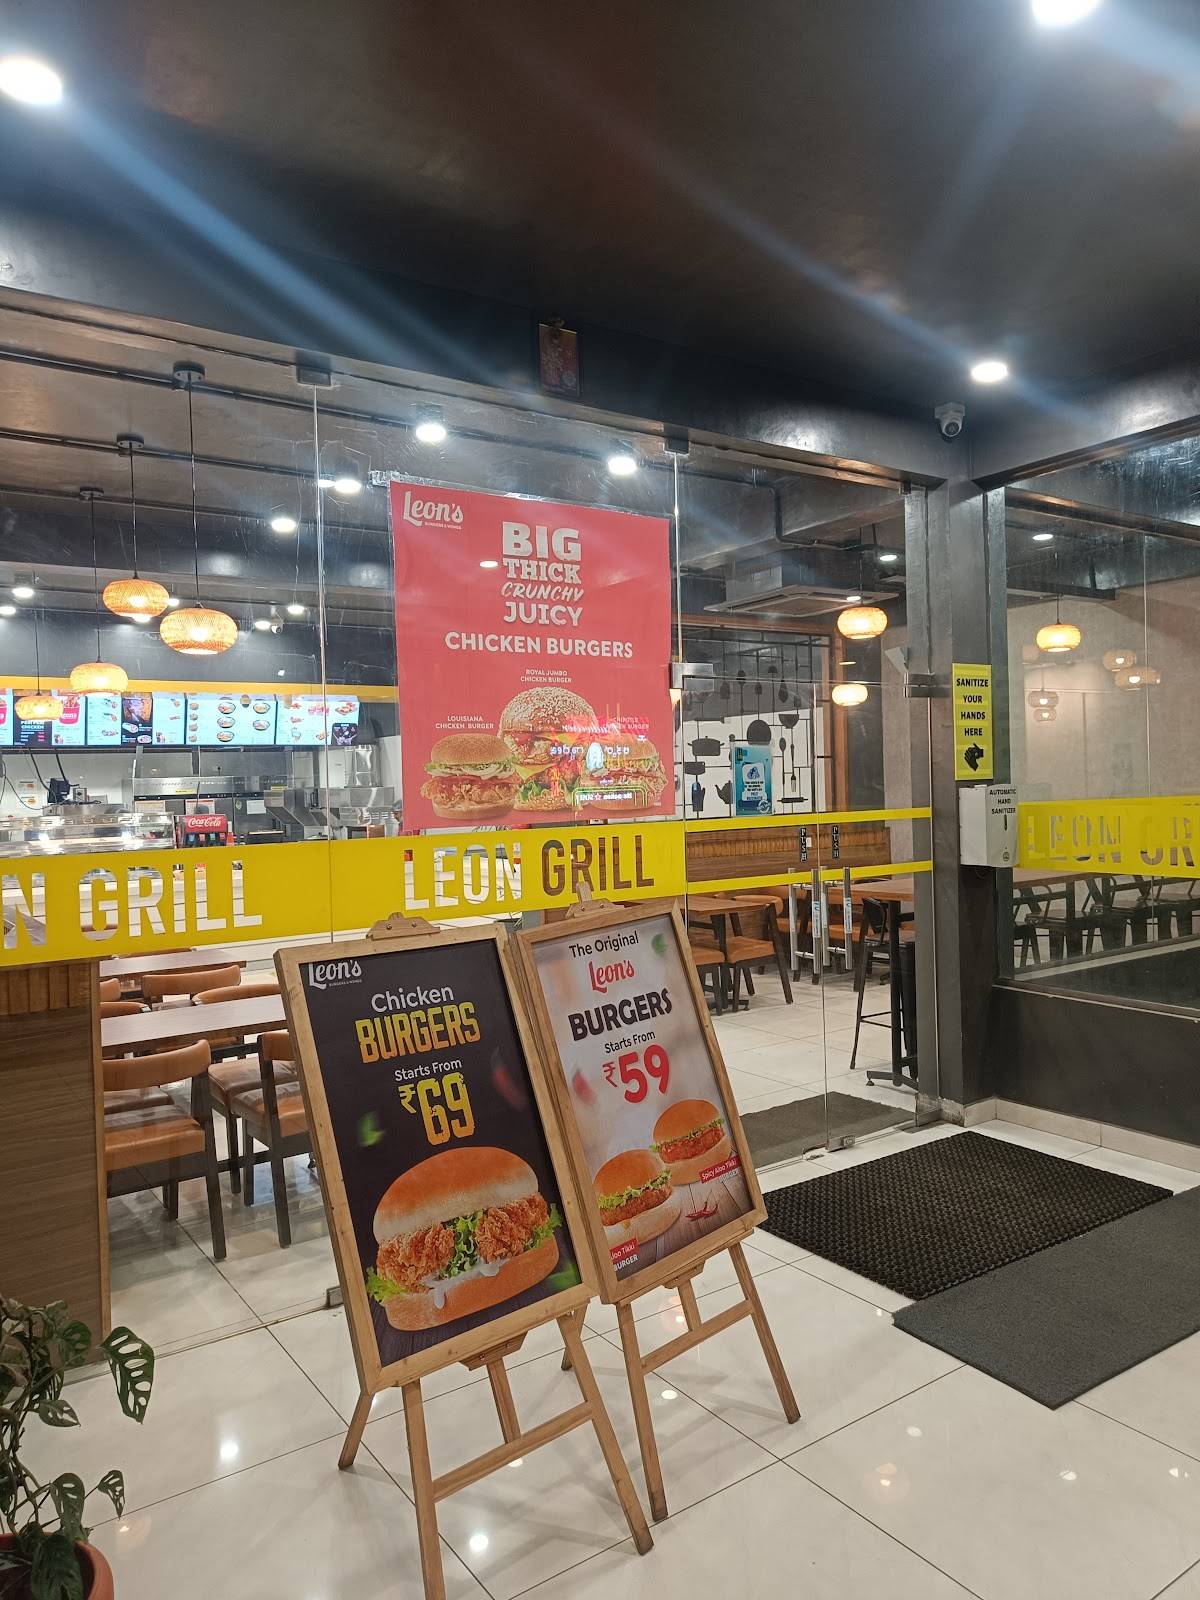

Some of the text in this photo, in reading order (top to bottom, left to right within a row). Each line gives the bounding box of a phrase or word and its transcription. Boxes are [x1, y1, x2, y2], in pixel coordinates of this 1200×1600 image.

[403, 490, 464, 527] Leon's
[502, 521, 582, 562] BIG
[502, 557, 582, 585] THICK
[501, 581, 584, 602] CRUNCHY
[503, 601, 583, 627] JUICY
[444, 631, 634, 659] CHICKEN BURGERS
[520, 675, 572, 684] CHICKEN BURGER
[525, 668, 568, 677] ROYAL JUMBO
[956, 677, 989, 688] SANITIZE
[962, 694, 983, 704] YOUR
[960, 710, 986, 721] HANDS
[964, 727, 983, 737] HERE
[989, 788, 1017, 796] AUTOMATIC
[991, 807, 1016, 815] SANITIZER
[1025, 815, 1122, 864] LEON
[404, 834, 655, 911] LEON GRILL
[79, 860, 263, 942] GRILL
[569, 930, 640, 959] The Original
[308, 960, 362, 990] Leon's
[588, 959, 635, 994] Leon's
[371, 985, 455, 1014] Chicken
[568, 987, 673, 1042] BURGERS
[355, 1001, 481, 1064] BURGERS
[604, 1029, 656, 1055] Starts From
[394, 1057, 463, 1082] Starts From
[602, 1044, 671, 1104] ₹59
[398, 1071, 476, 1147] ₹69
[701, 1158, 738, 1181] Spicy Aloo Tikki
[621, 1242, 635, 1255] Tikki
[613, 1253, 639, 1272] BURGER
